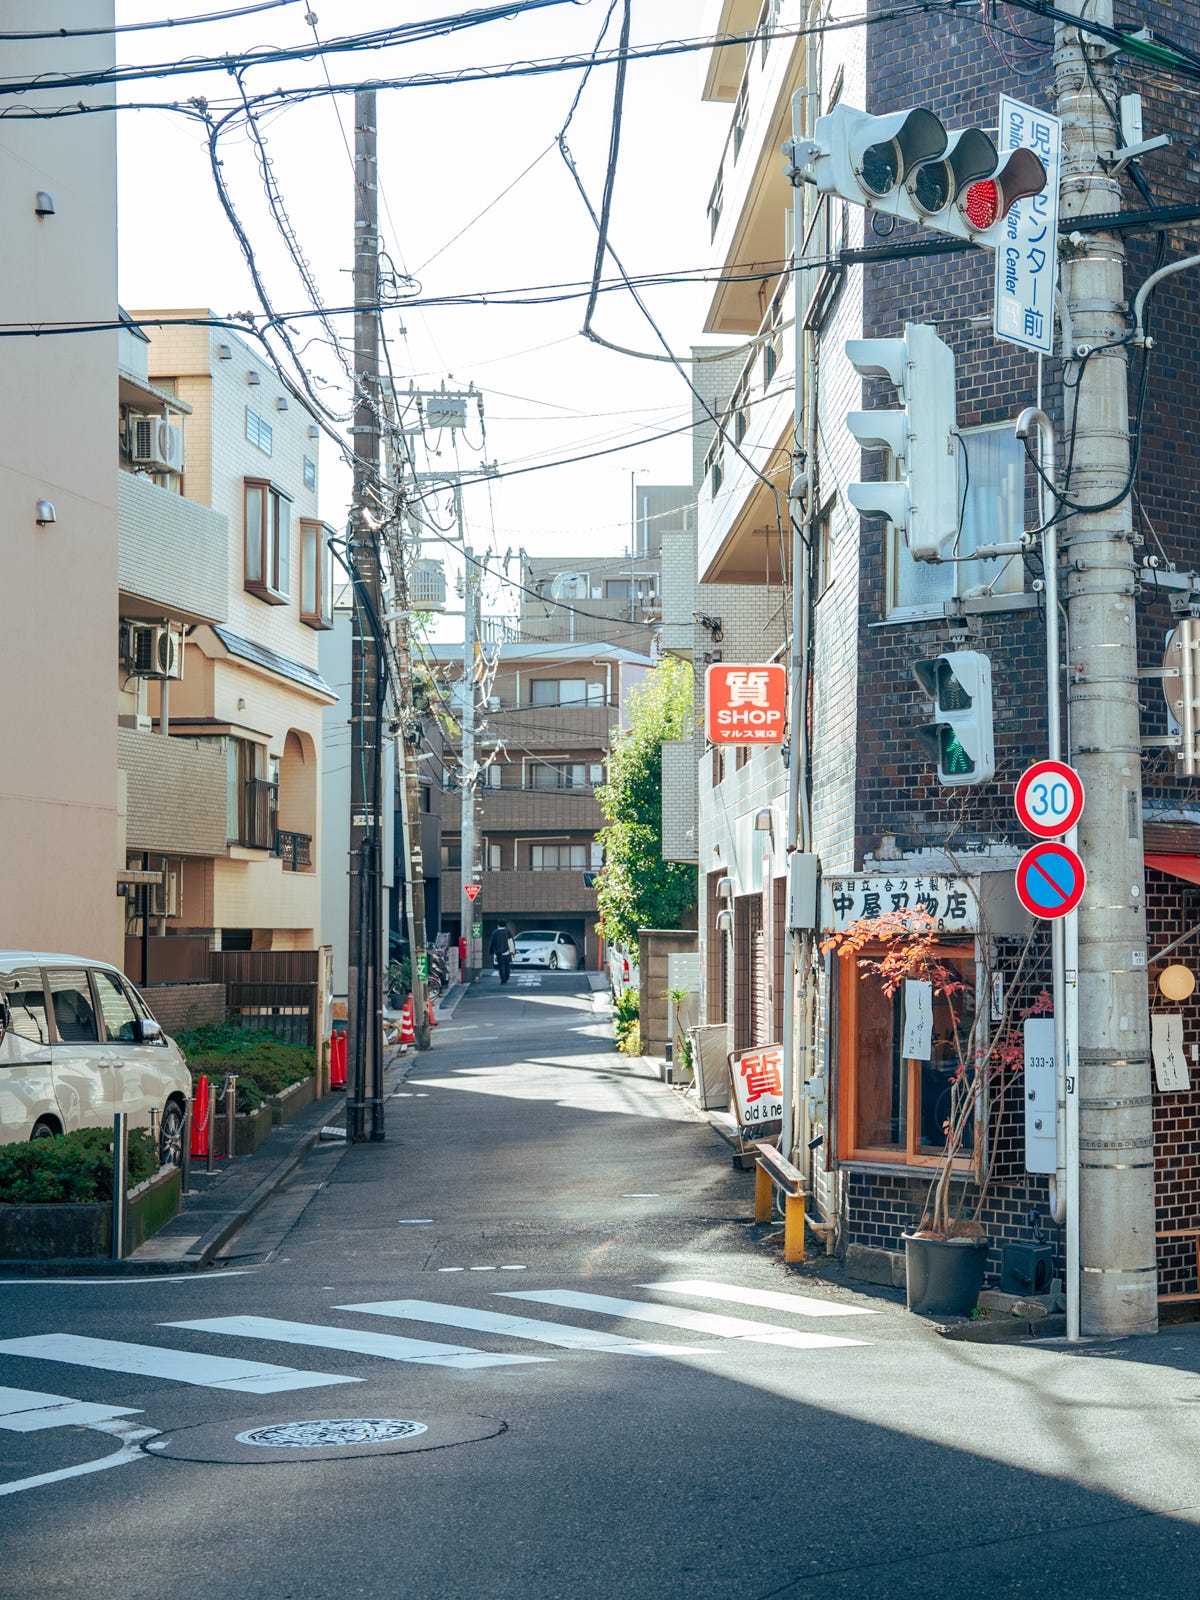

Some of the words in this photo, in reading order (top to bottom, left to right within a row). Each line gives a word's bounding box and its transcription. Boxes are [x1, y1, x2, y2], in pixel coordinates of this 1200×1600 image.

[1005, 247, 1020, 295] Center
[725, 671, 770, 708] 質
[717, 709, 780, 725] SHOP
[1032, 783, 1068, 816] 30
[832, 889, 968, 921] 中屋刃物店
[741, 1051, 784, 1103] 質
[744, 1104, 759, 1121] old
[762, 1105, 768, 1117] &
[770, 1104, 782, 1117] ne
